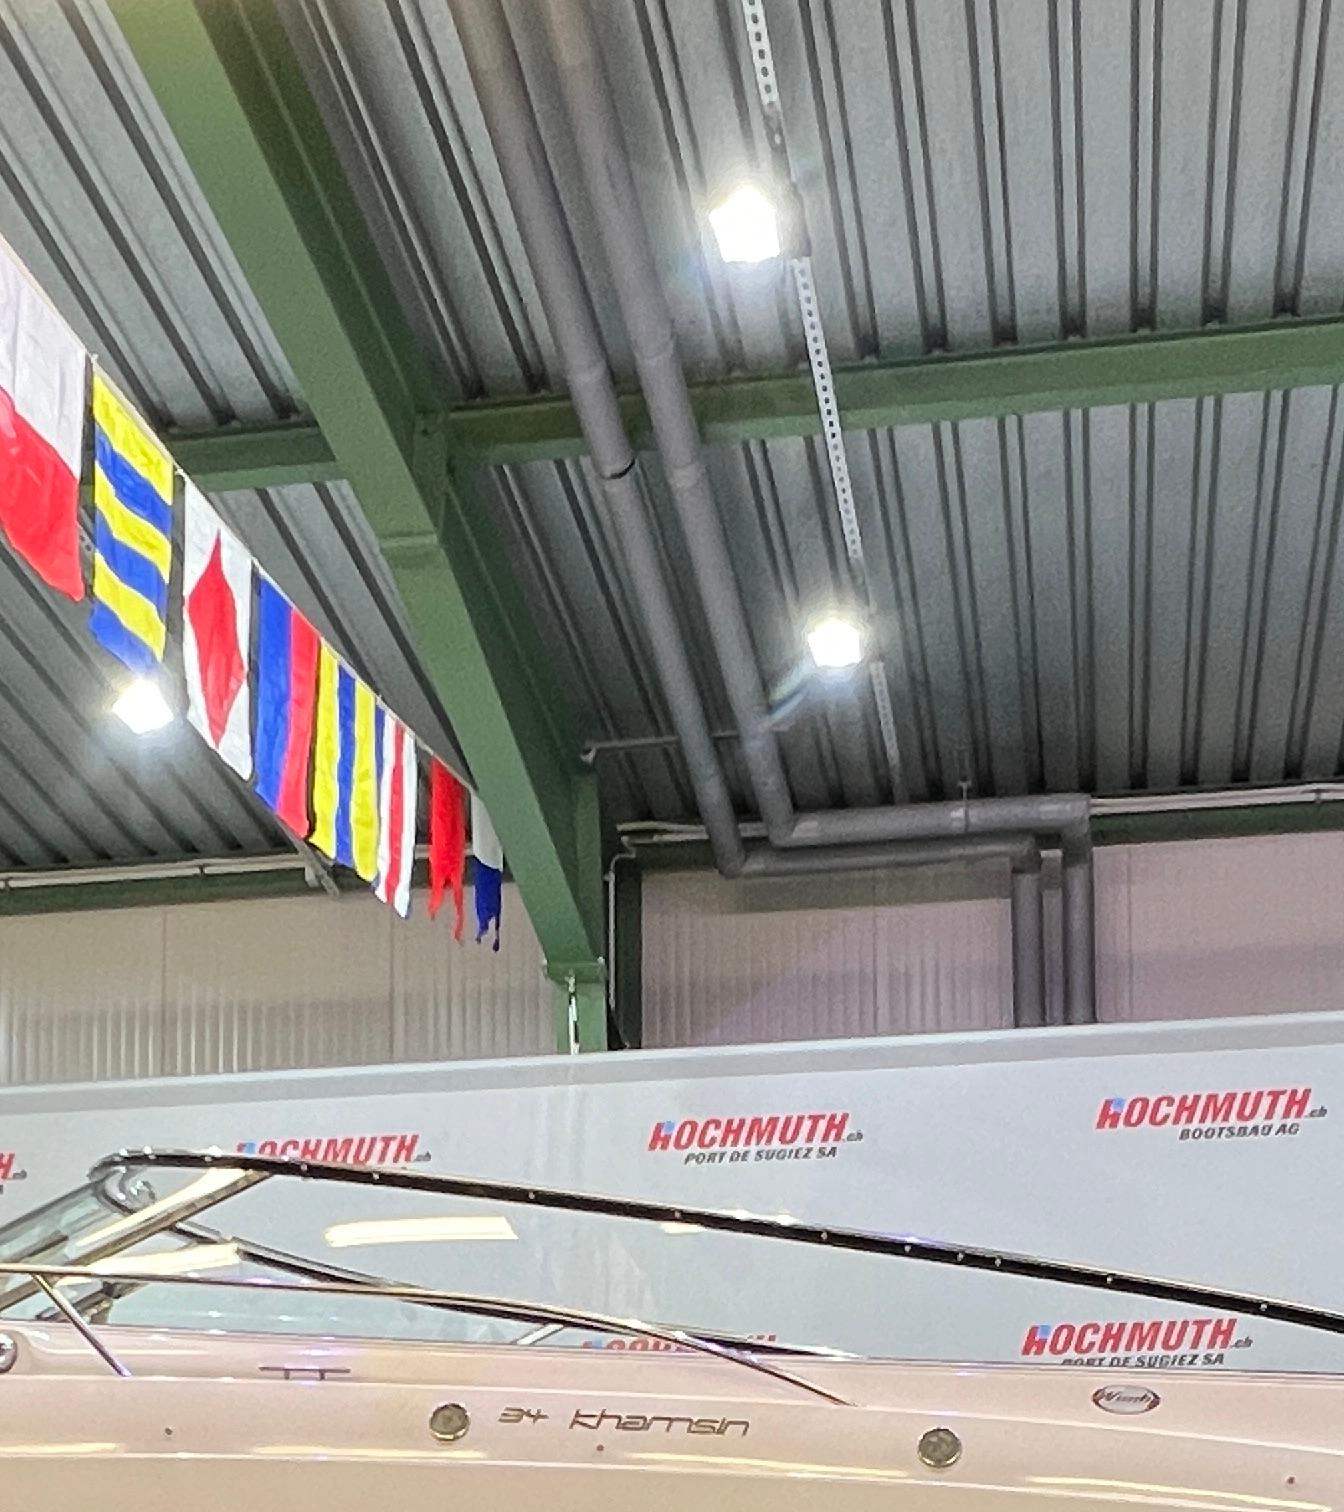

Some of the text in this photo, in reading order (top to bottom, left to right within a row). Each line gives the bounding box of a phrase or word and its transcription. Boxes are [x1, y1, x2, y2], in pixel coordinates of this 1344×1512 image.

[1179, 1123, 1301, 1141] BOOTSBAU AG
[684, 1146, 838, 1165] PORT DE SUGIEZ SA
[1202, 1353, 1225, 1365] SA
[498, 1407, 549, 1424] 34
